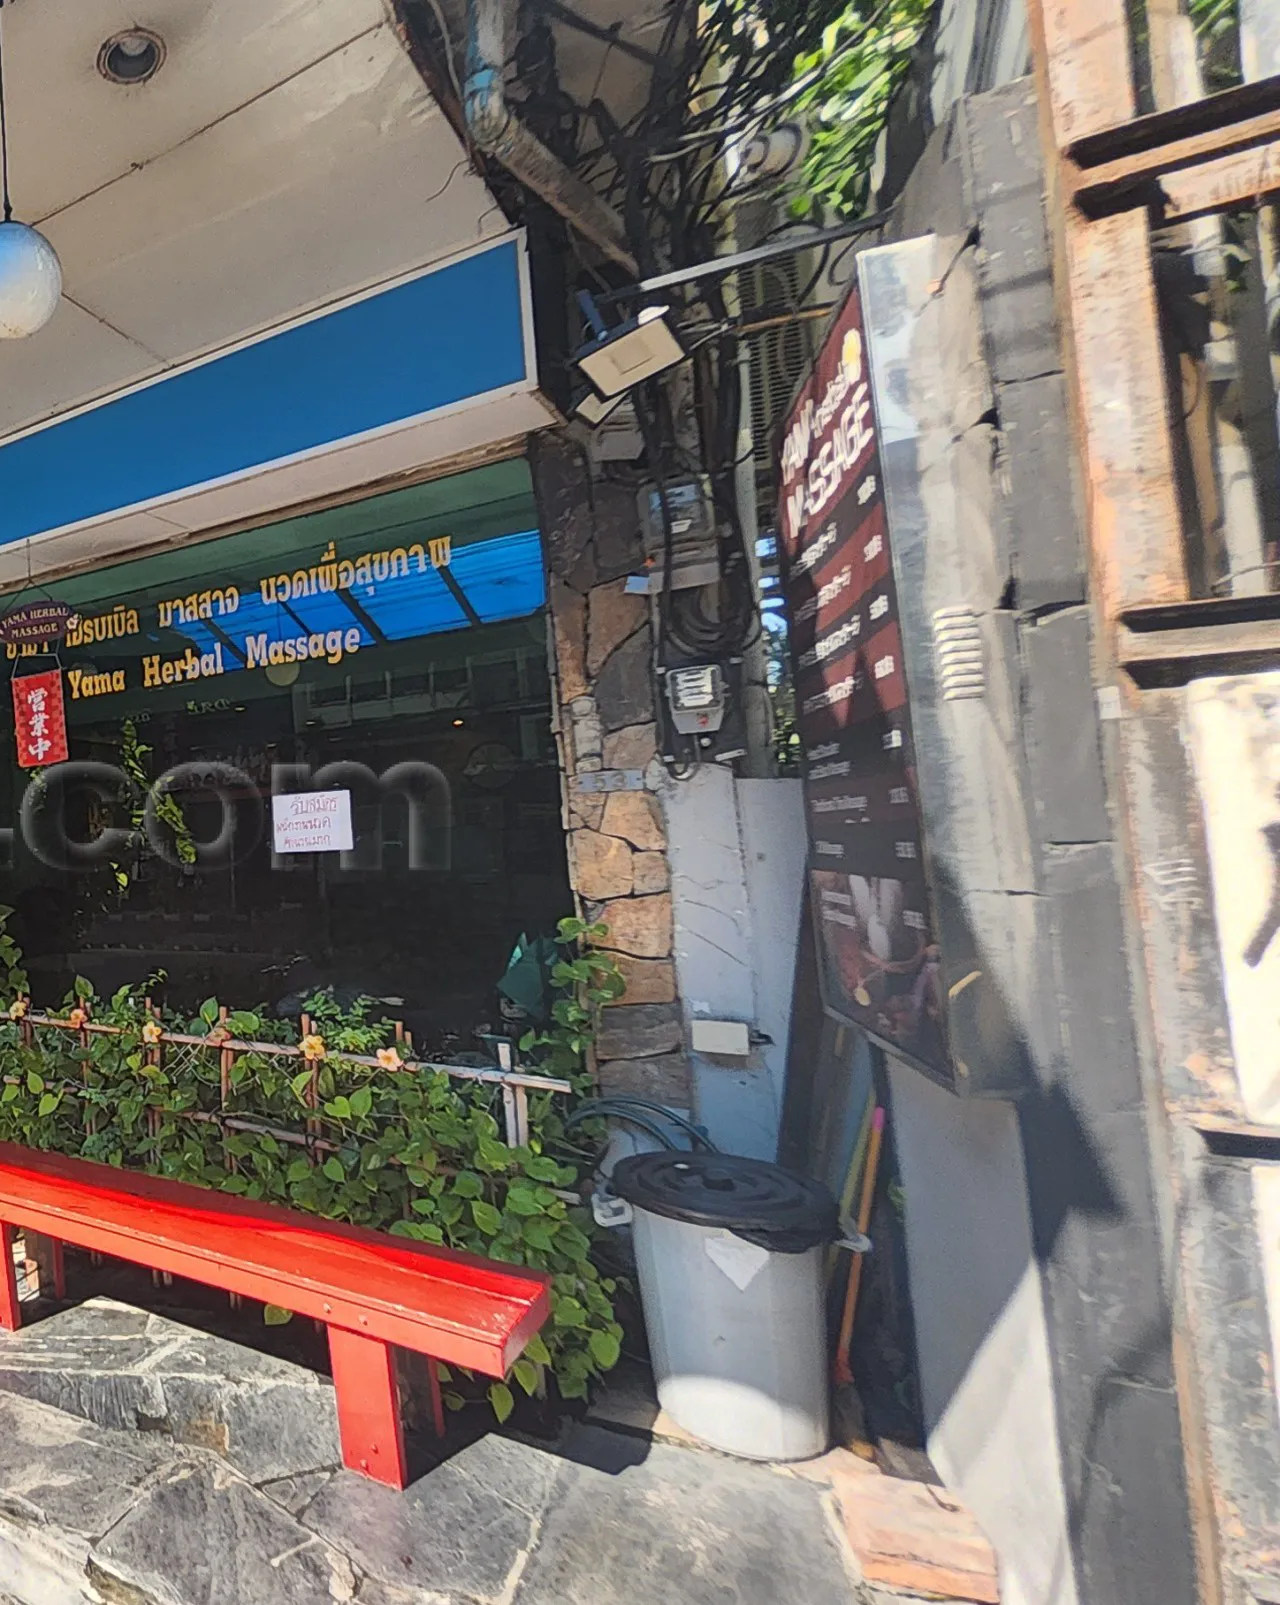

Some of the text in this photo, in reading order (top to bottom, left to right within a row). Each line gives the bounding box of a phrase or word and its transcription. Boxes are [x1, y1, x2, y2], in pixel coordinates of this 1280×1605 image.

[1, 607, 69, 629] YAMA HERBAL
[158, 586, 239, 628] มาสสาจ
[11, 622, 58, 639] MASSAGE
[68, 627, 361, 700] Yama Herbal Massage
